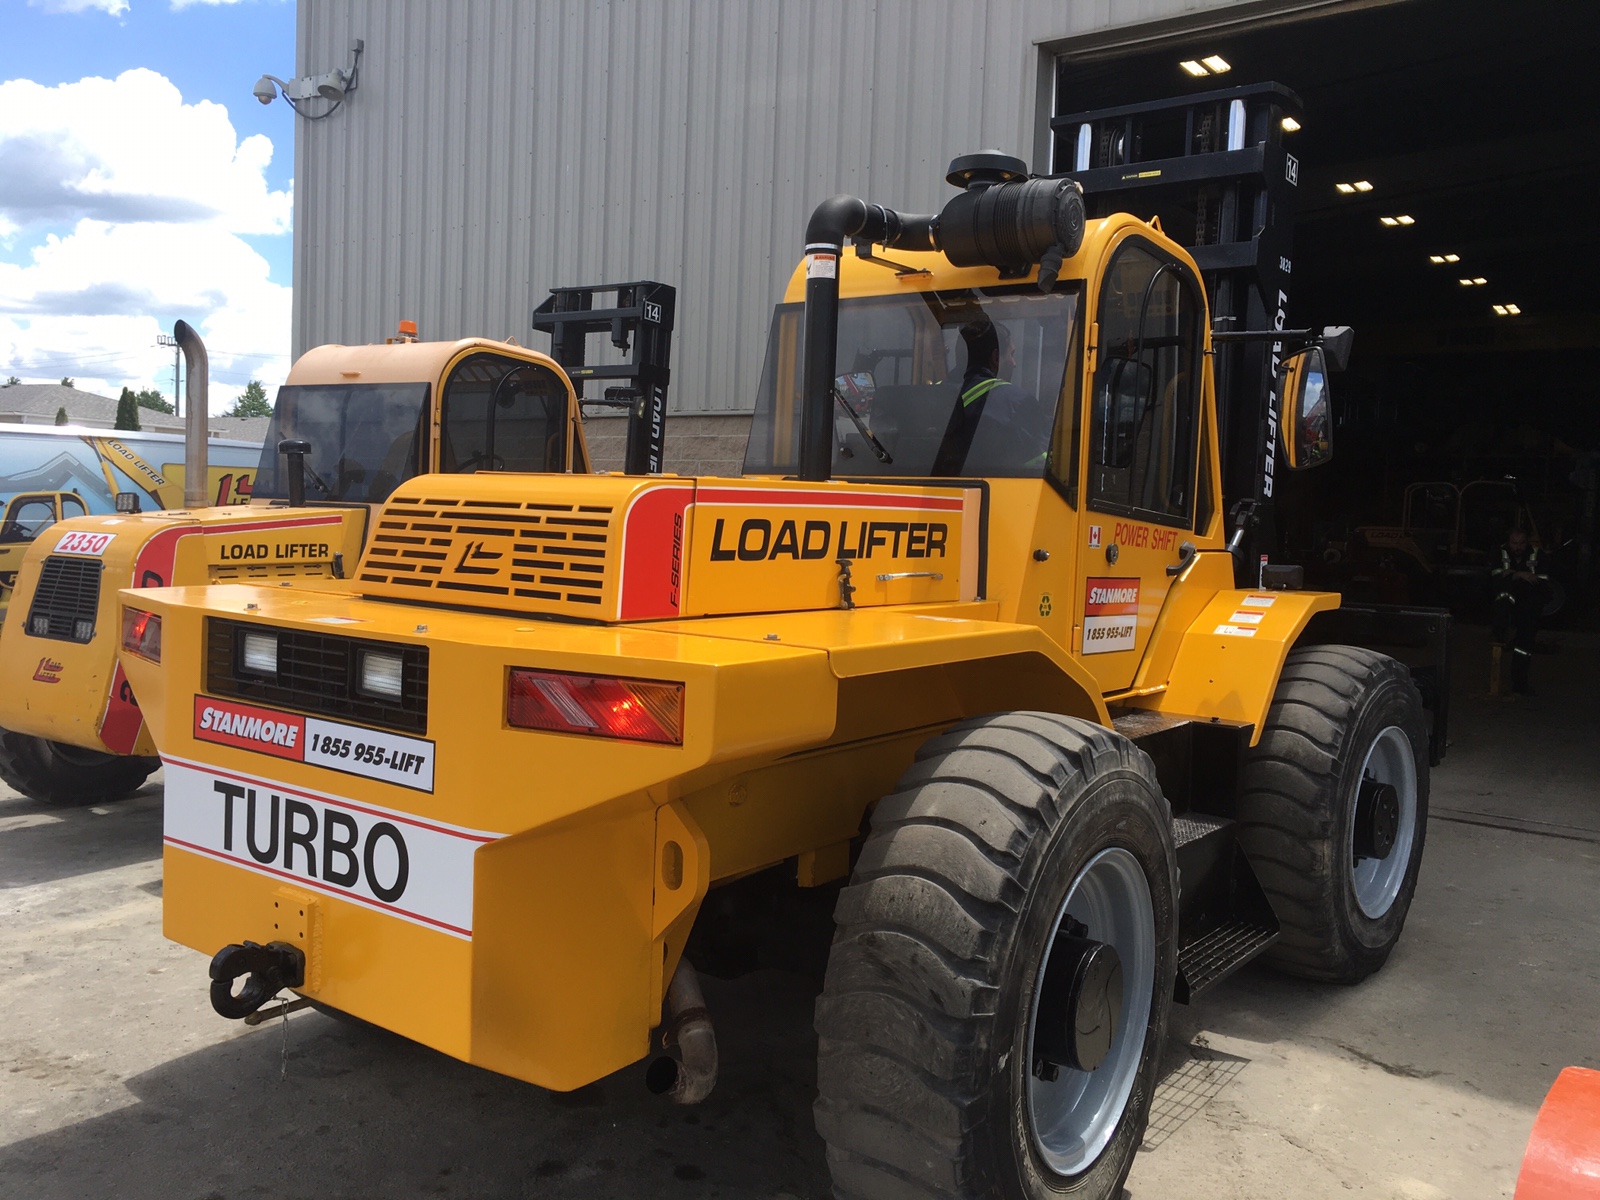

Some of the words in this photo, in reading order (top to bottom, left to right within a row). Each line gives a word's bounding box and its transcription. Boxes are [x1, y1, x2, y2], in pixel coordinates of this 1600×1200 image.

[1287, 158, 1297, 182] 14
[646, 303, 660, 322] 14
[649, 443, 659, 473] LIF
[1263, 390, 1277, 498] LIFTER
[107, 439, 135, 461] LOAD
[133, 460, 165, 486] LIFTER
[59, 533, 109, 553] 2350
[220, 544, 269, 560] LOAD
[275, 543, 329, 559] LIFTER
[710, 518, 831, 563] LOAD
[836, 522, 949, 560] LIFTER
[1113, 522, 1149, 548] POWER
[1151, 529, 1178, 552] SHIFT
[670, 512, 682, 608] F-SERIES
[1088, 586, 1138, 605] STANMORE
[1086, 627, 1092, 641] 1
[1092, 626, 1105, 640] 855
[1105, 625, 1133, 639] 955-LIFT
[199, 706, 299, 748] STANMORE
[311, 733, 320, 752] 1
[320, 736, 352, 759] 855
[353, 742, 425, 775] 955-LIFT
[213, 780, 410, 903] TURBO
